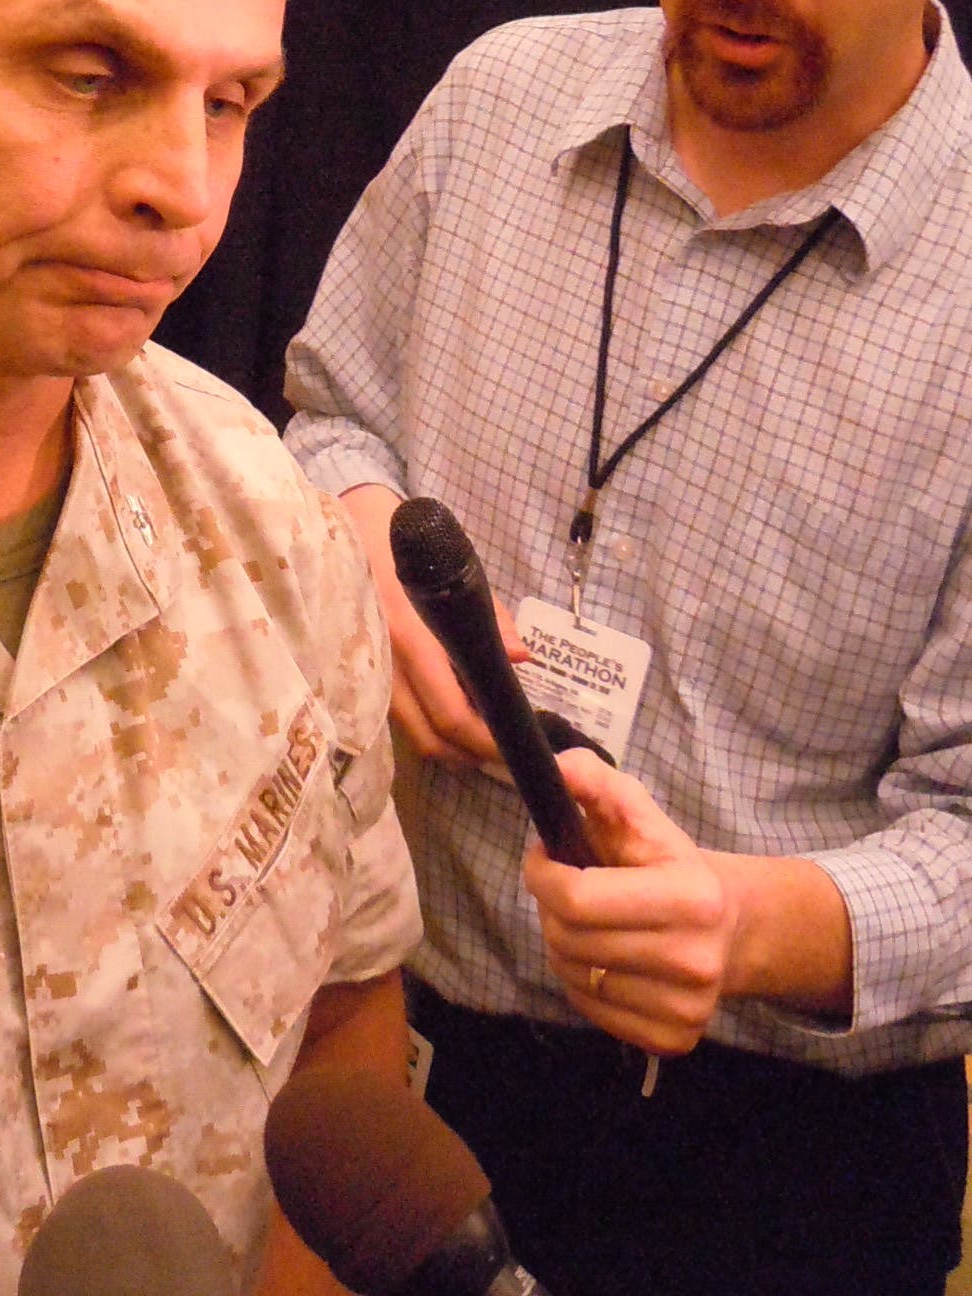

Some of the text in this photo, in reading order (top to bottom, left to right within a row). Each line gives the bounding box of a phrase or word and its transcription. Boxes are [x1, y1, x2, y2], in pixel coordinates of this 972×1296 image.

[520, 635, 628, 690] MARATHON
[530, 625, 624, 673] THE PEOPLE'S
[233, 727, 318, 872] MARINES
